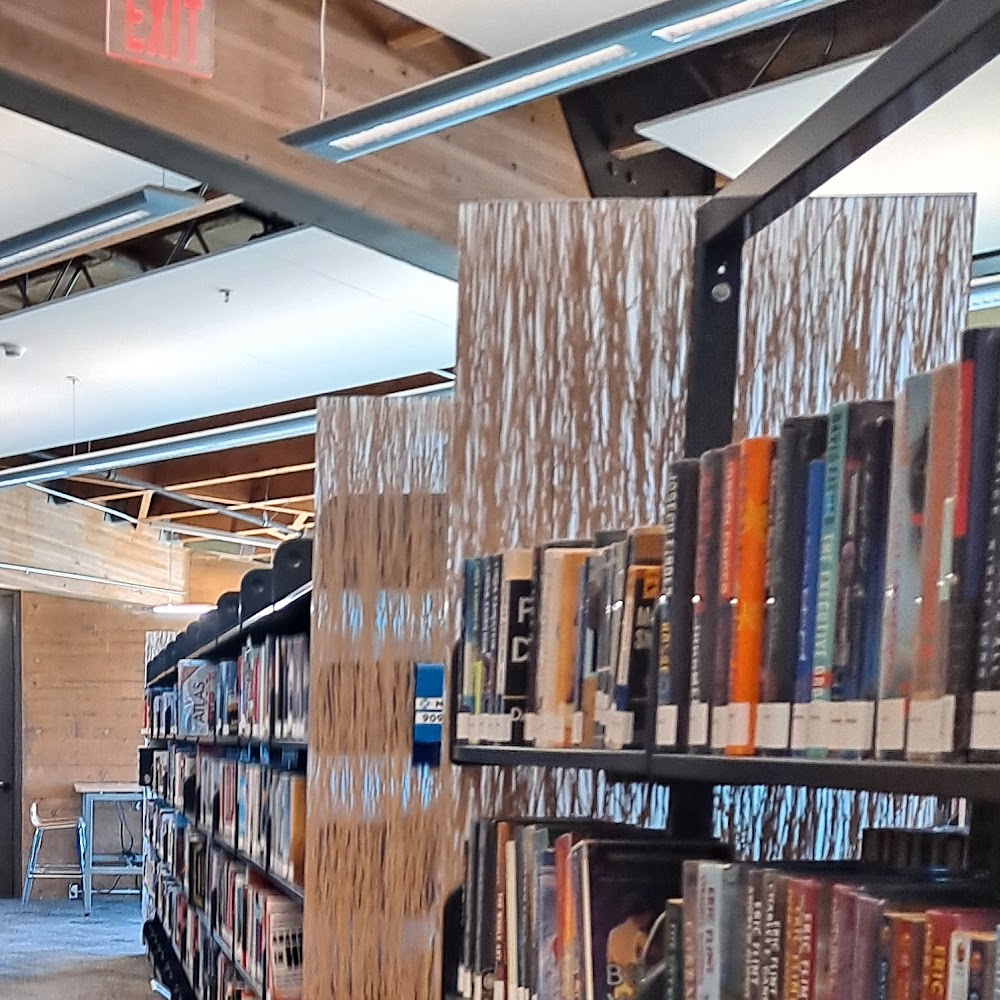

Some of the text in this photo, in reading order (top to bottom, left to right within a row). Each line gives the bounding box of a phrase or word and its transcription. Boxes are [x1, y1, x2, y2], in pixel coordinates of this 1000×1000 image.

[125, 0, 204, 65] EXIT
[193, 681, 207, 724] ATLAS
[802, 911, 812, 953] ERIC
[930, 945, 947, 996] ERIC
